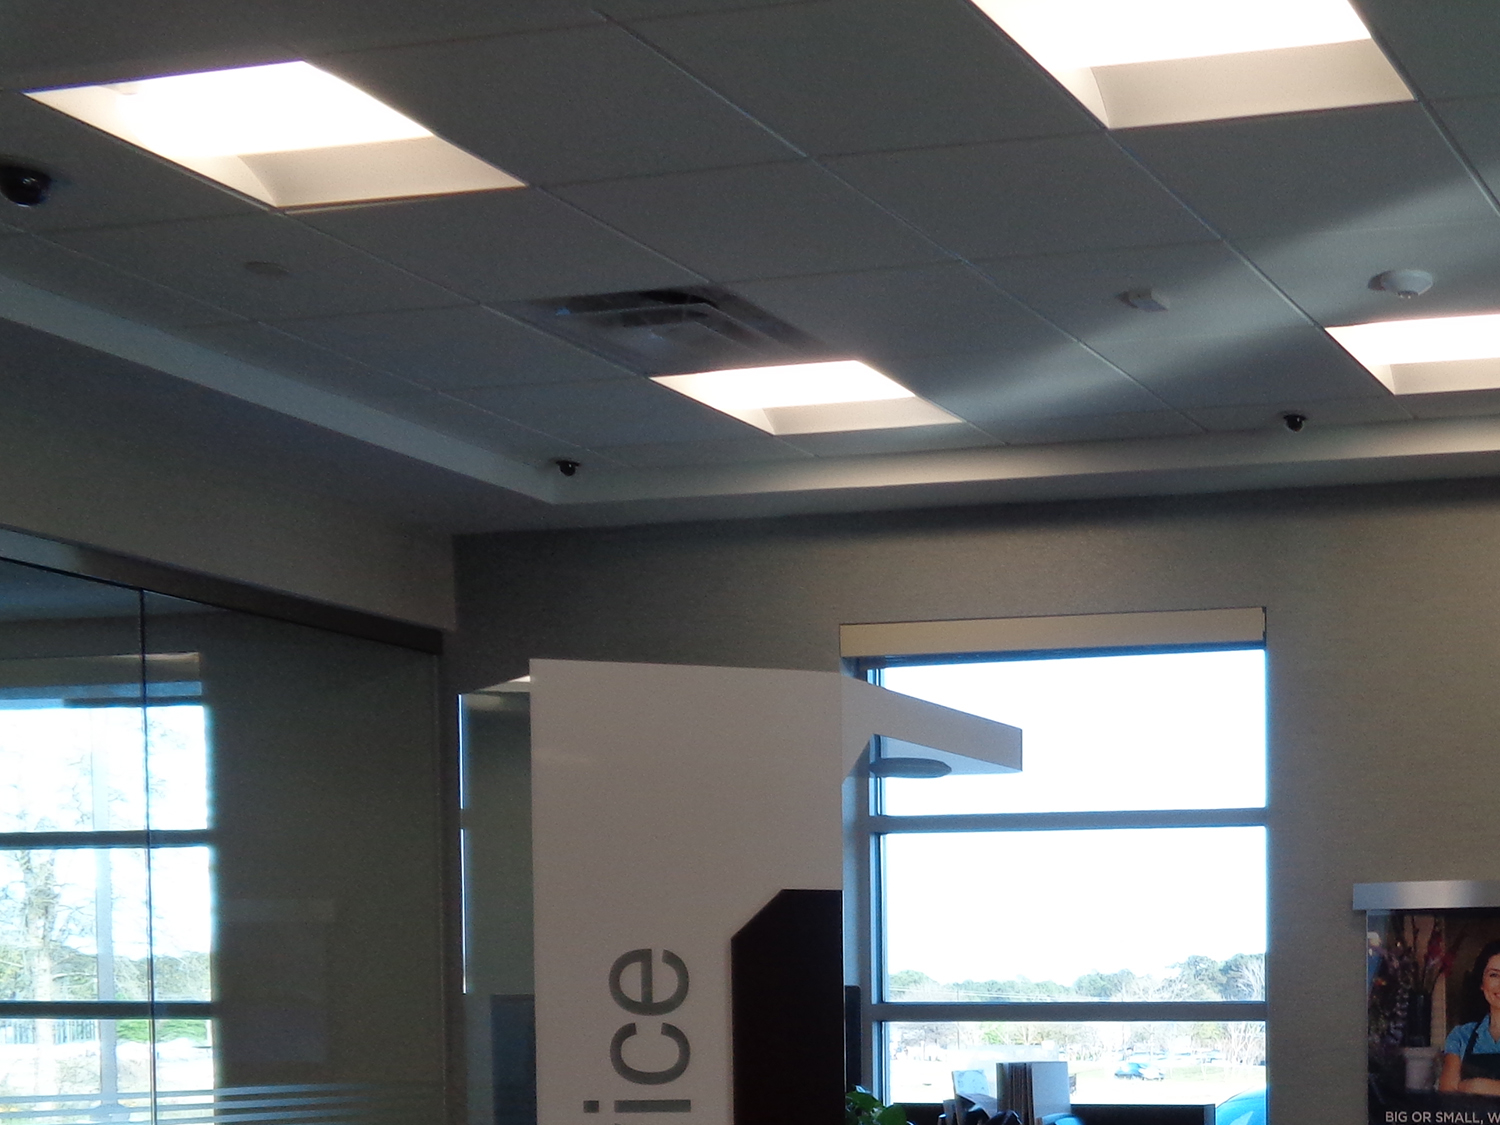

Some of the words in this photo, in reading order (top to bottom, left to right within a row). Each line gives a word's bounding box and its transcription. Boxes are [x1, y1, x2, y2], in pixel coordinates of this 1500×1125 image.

[1385, 1111, 1408, 1123] BIG
[1411, 1111, 1431, 1123] OR
[1435, 1111, 1484, 1125] SMALL,
